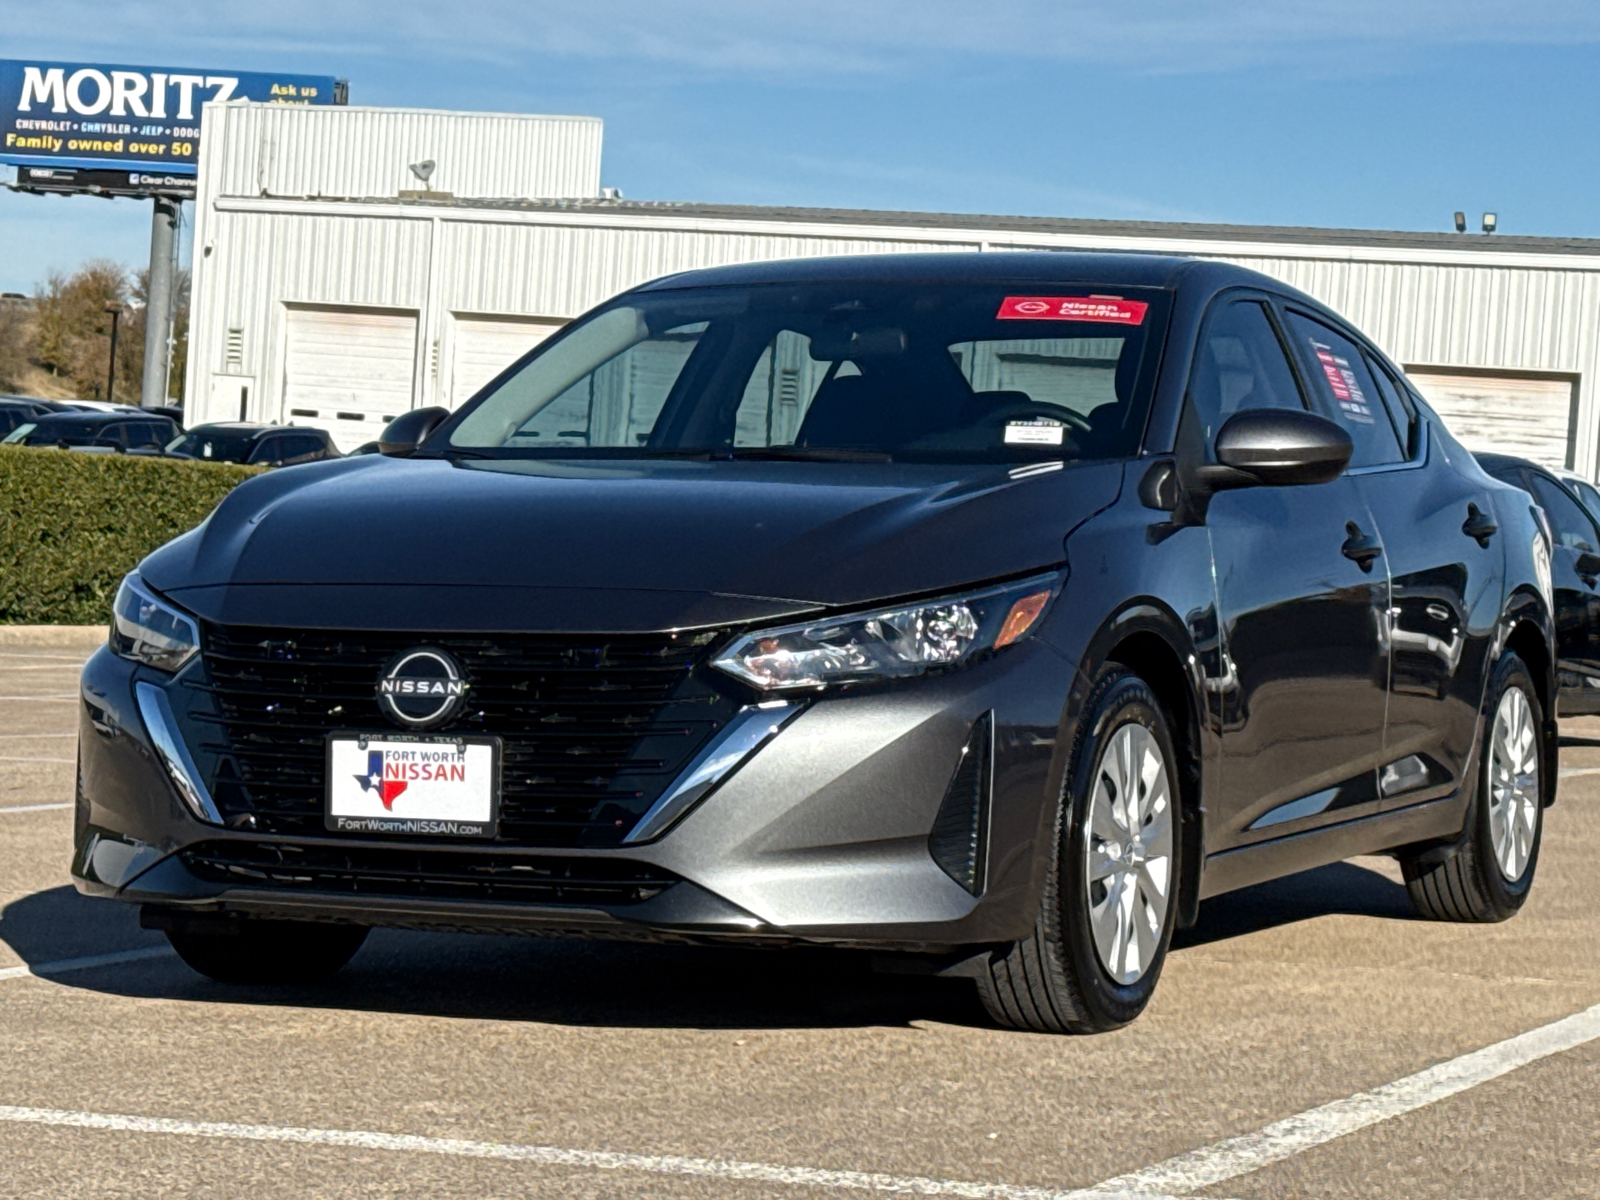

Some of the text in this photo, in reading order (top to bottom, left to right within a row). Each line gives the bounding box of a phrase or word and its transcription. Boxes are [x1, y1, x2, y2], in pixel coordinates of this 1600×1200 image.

[17, 66, 249, 119] MORITZ
[270, 83, 318, 97] Ask us
[15, 118, 200, 138] CHEVROLET CHRYSLER JEEP DODG
[6, 133, 63, 152] Family
[67, 138, 124, 152] owned
[129, 142, 167, 154] over
[171, 142, 192, 156] 50
[140, 174, 198, 187] Clear Channe
[1059, 308, 1132, 319] Certified
[1061, 302, 1119, 312] Nissan
[381, 679, 463, 695] NISSAN
[360, 733, 463, 745] FORT WORTH TEXAS
[385, 750, 465, 763] FORT WORTH
[385, 762, 466, 782] NISSAN
